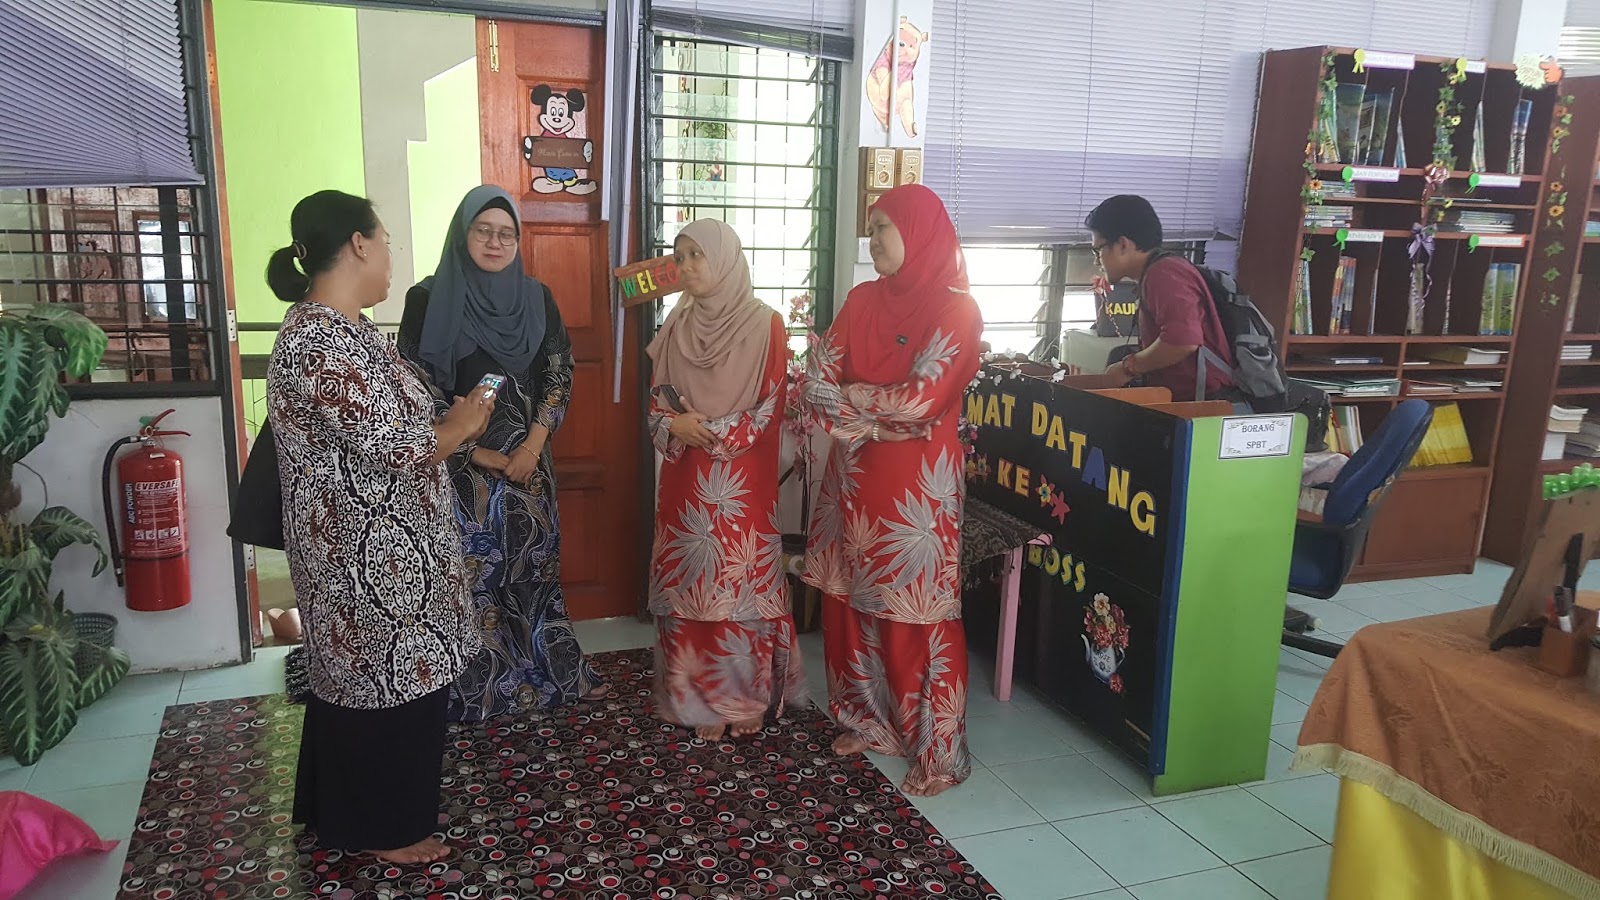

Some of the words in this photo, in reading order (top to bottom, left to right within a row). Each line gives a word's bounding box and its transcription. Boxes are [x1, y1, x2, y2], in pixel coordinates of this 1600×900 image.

[1241, 423, 1275, 433] BORANG
[1245, 440, 1267, 449] SPBT
[967, 393, 1016, 427] MAT
[1031, 401, 1156, 537] DATANG
[997, 458, 1031, 498] KE
[1027, 544, 1087, 593] BOSS
